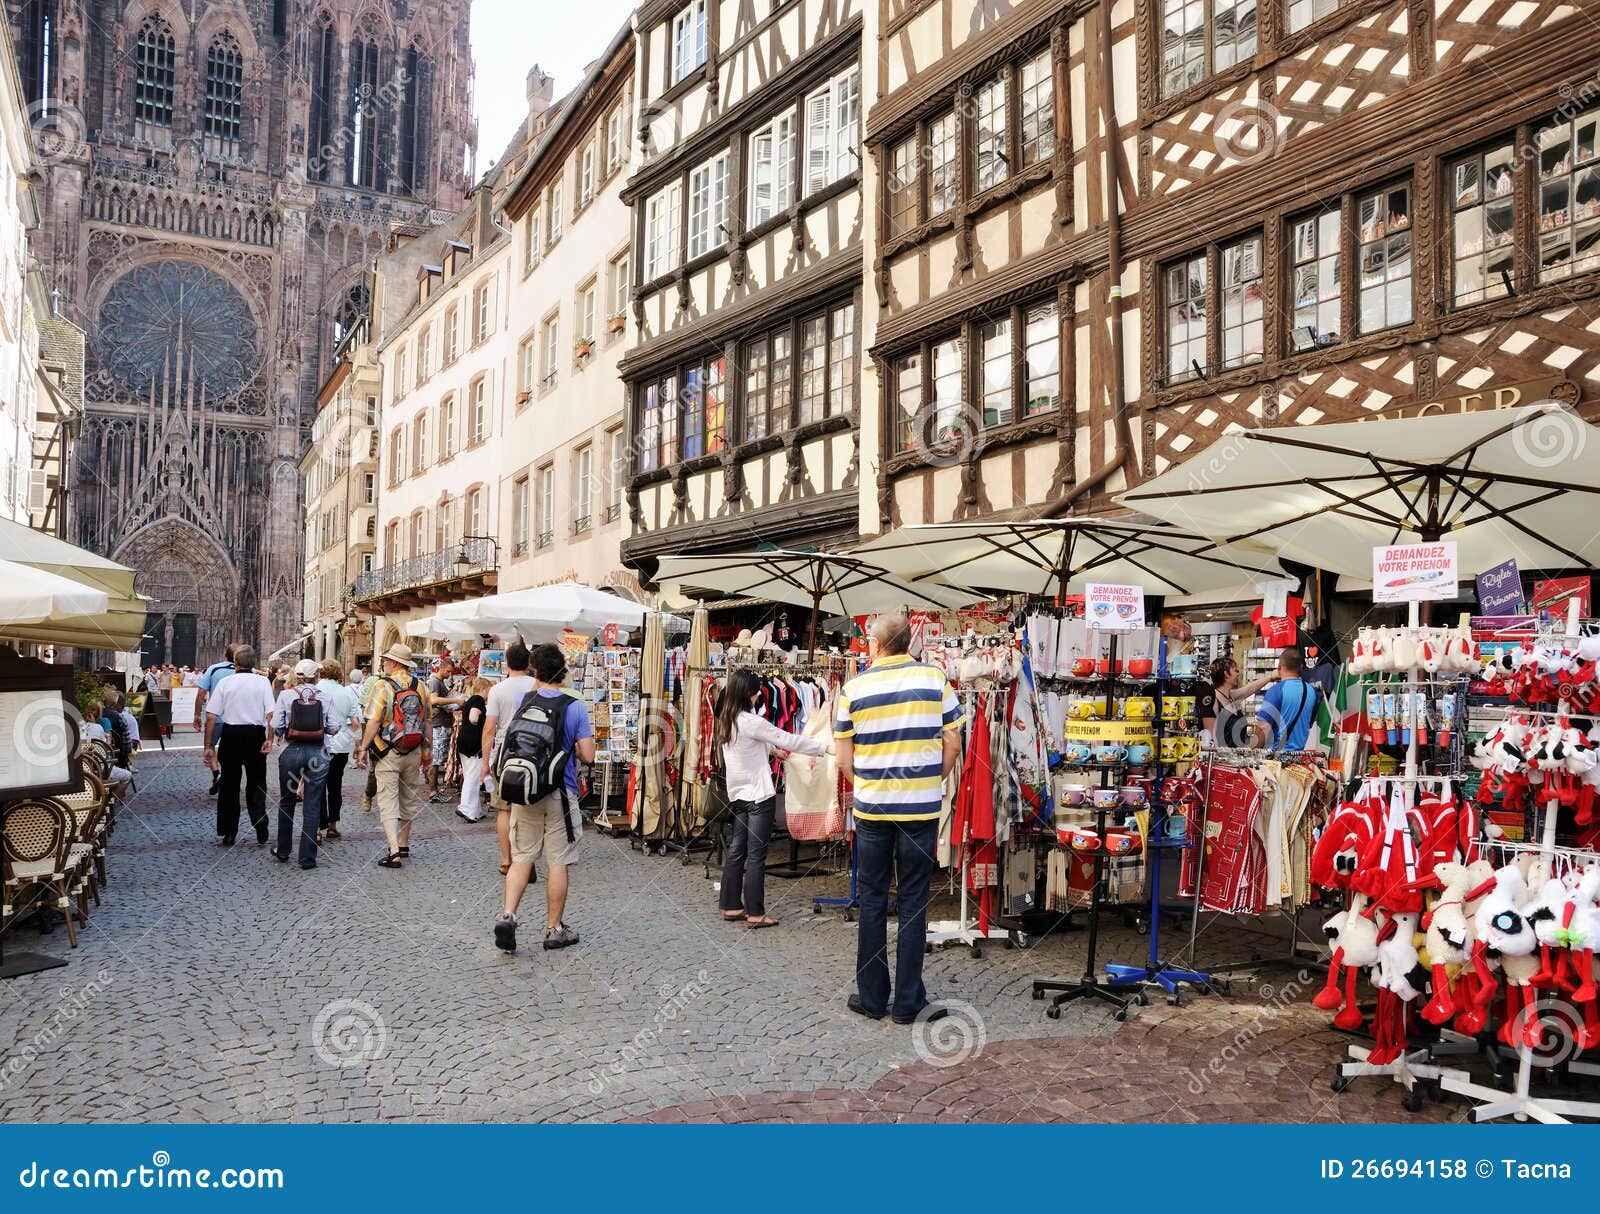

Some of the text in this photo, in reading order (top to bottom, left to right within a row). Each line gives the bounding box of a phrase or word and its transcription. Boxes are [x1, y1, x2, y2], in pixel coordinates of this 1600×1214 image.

[1385, 546, 1445, 561] DEMANDEZ
[1378, 559, 1451, 573] VOTRE PRENOM
[1093, 586, 1133, 595] DEMANDEZ
[1090, 594, 1111, 602] VOTRE
